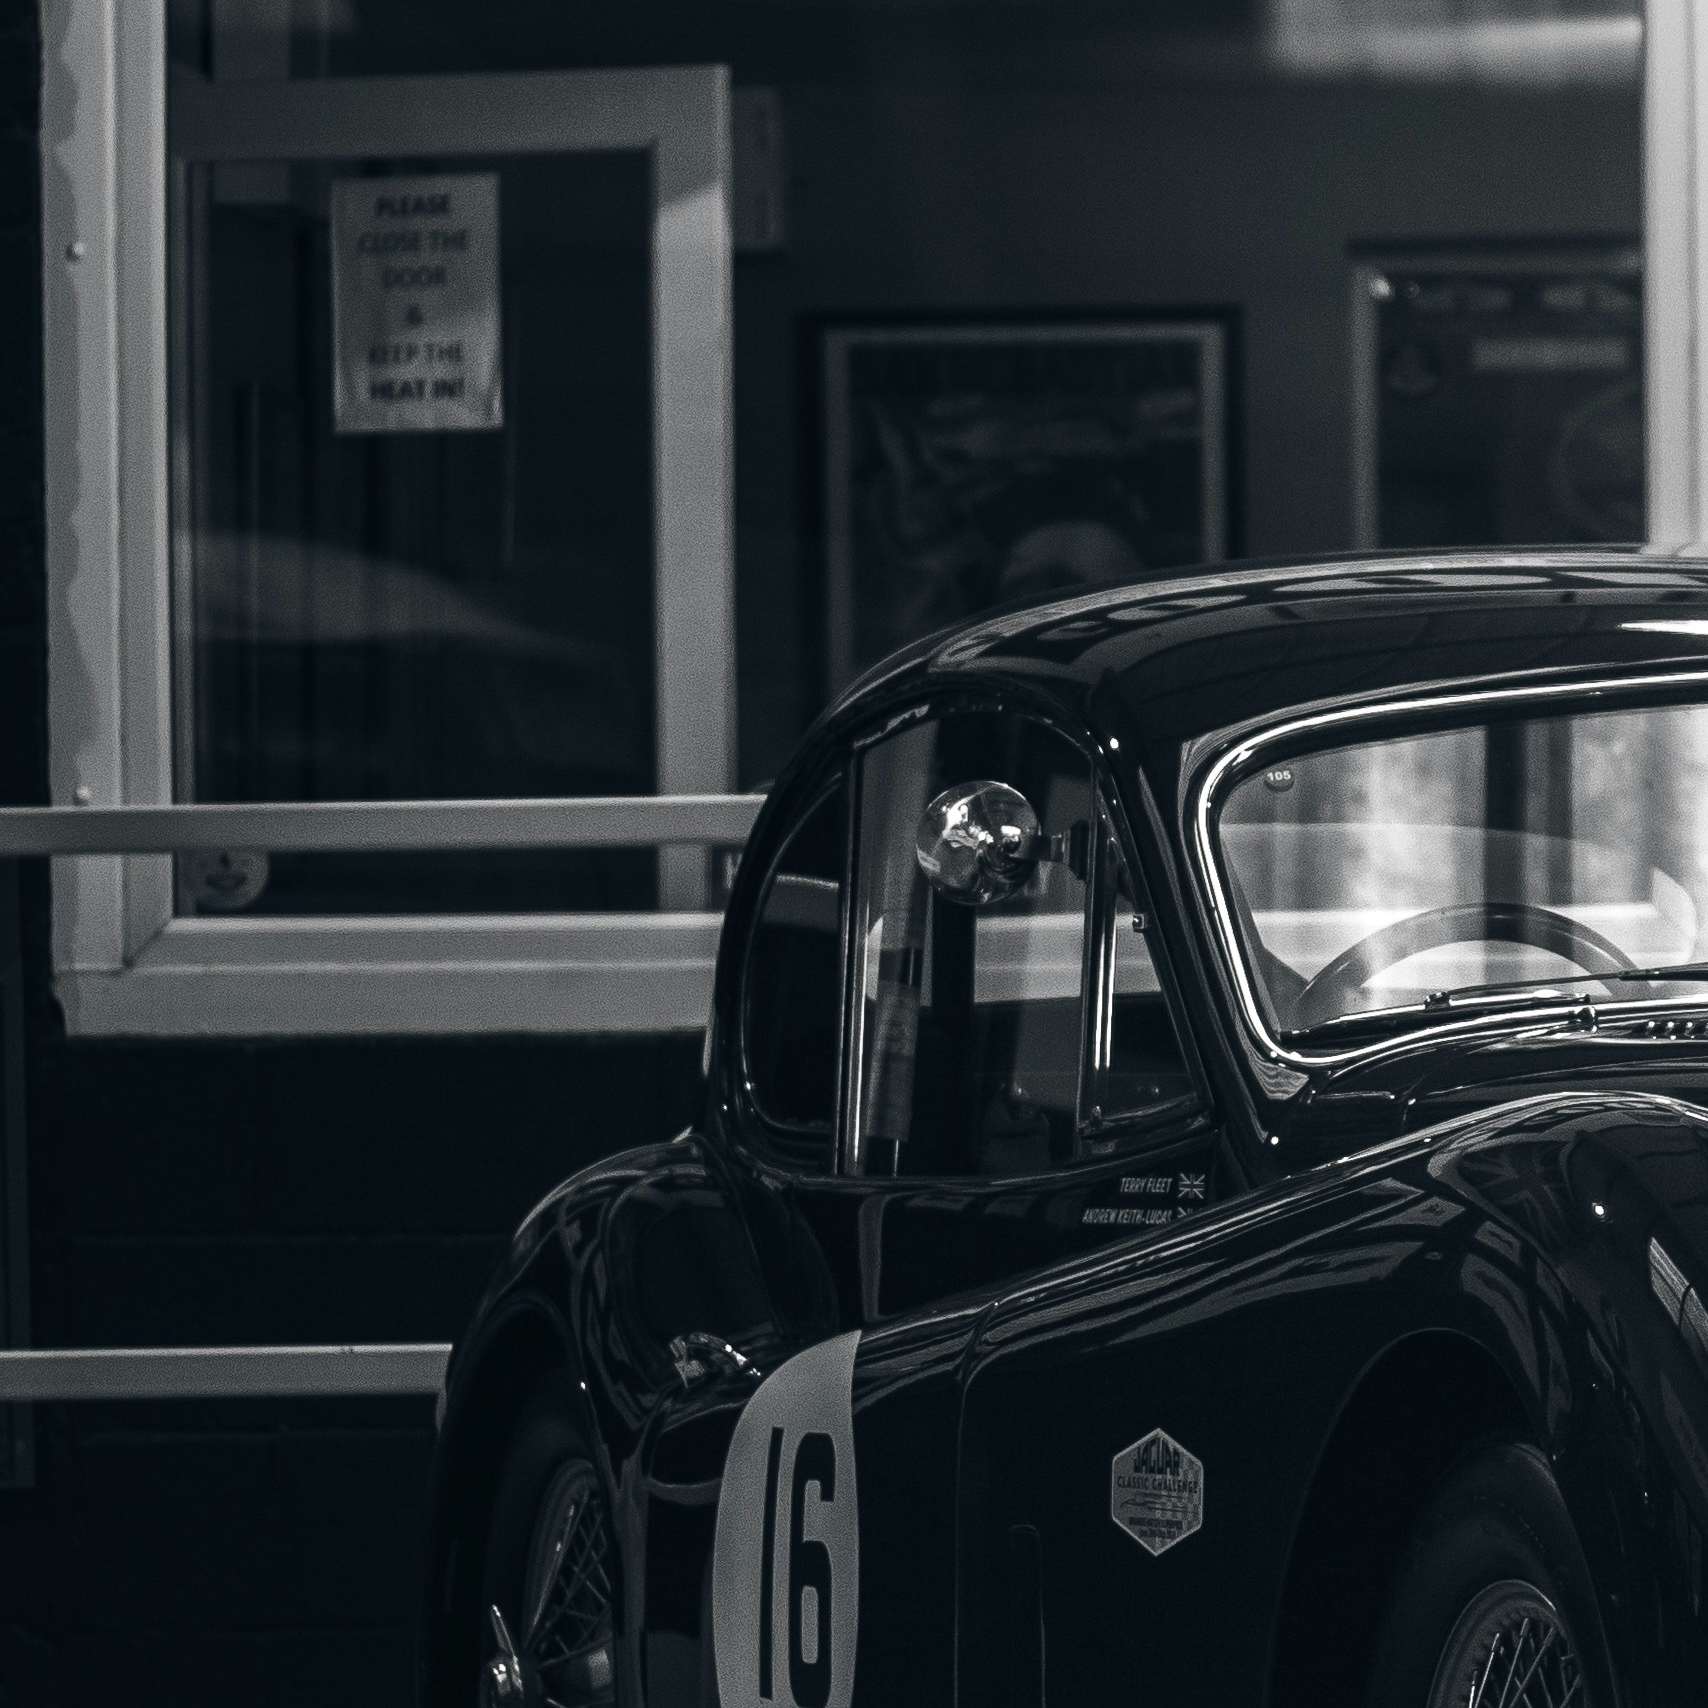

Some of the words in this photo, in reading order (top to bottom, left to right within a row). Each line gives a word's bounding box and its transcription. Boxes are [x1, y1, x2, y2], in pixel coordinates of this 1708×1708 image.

[375, 196, 451, 217] PLEASE
[357, 231, 421, 254] CLOSE
[429, 230, 469, 251] THE
[381, 268, 446, 290] DOOR
[405, 306, 424, 327] &
[368, 344, 418, 365] KEEP
[427, 342, 464, 363] THE
[369, 380, 425, 401] HEAT
[1120, 1178, 1146, 1193] TERRY
[1147, 1178, 1172, 1193] FLEET
[1082, 1209, 1116, 1224] ANDREW
[1134, 1436, 1181, 1477] JAGUAR
[1117, 1476, 1149, 1489] CLASSIC
[1151, 1478, 1199, 1495] CHALLENGE
